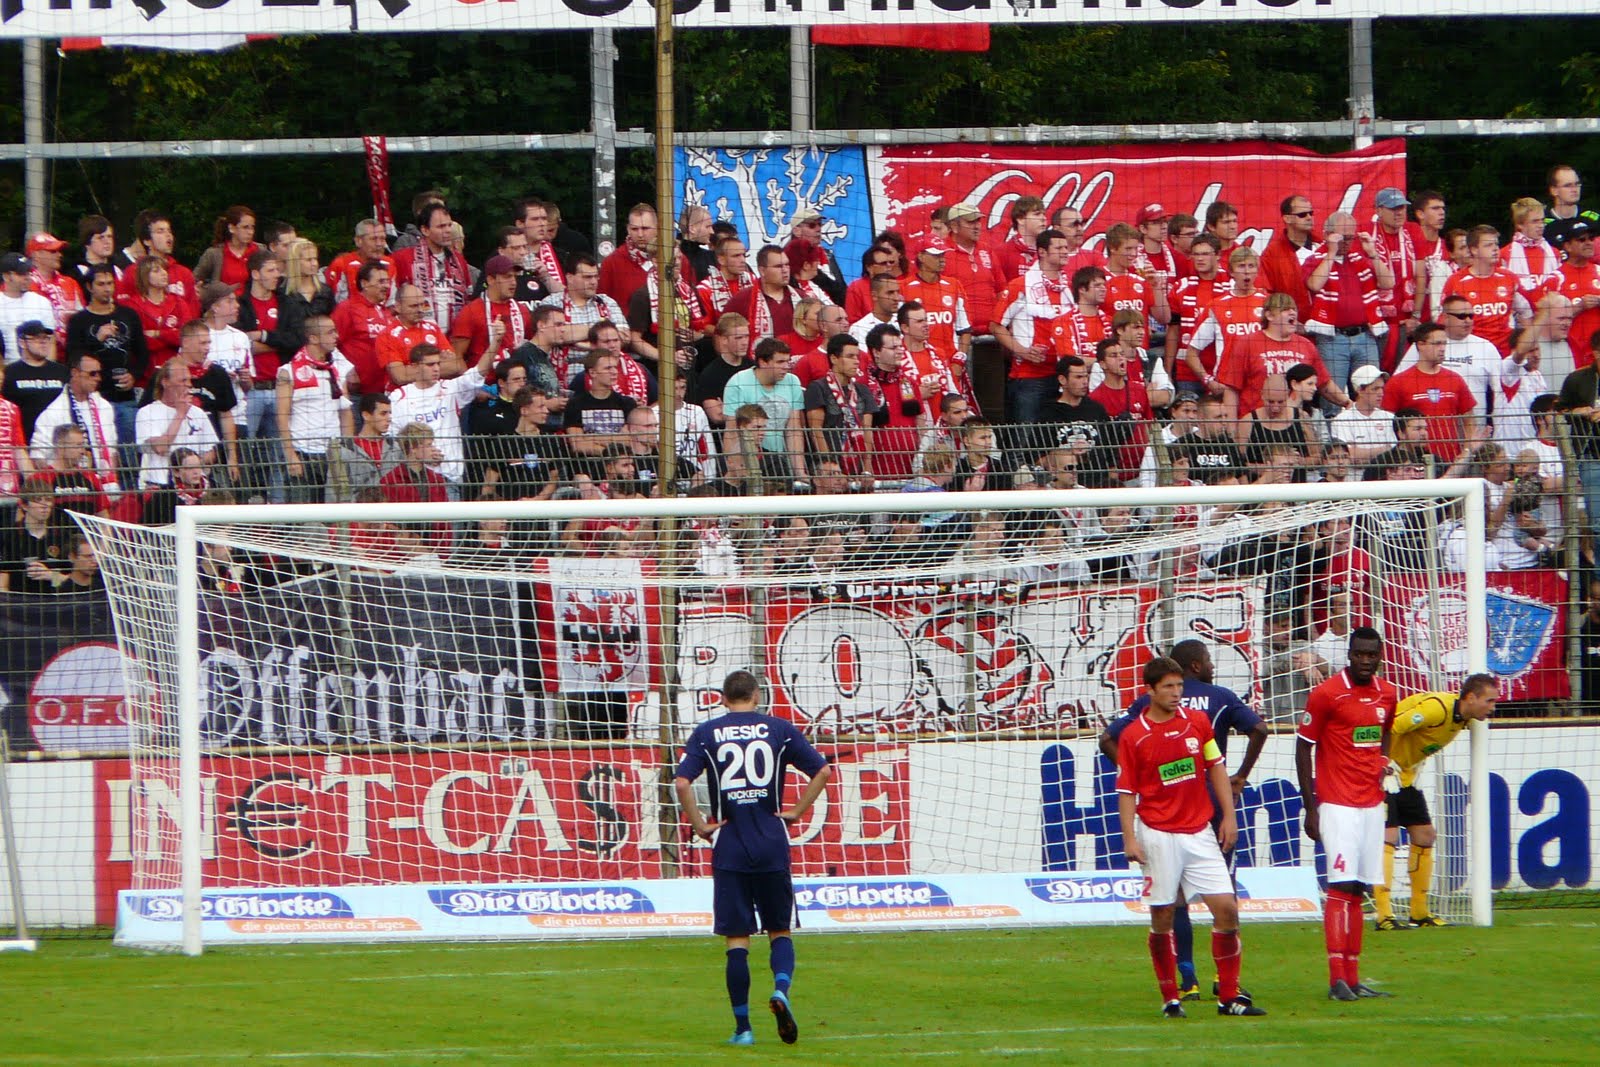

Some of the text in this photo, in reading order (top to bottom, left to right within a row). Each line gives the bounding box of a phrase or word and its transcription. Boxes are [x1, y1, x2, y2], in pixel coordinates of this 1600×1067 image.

[713, 723, 769, 743] MESIC
[717, 740, 775, 791] 20
[727, 788, 769, 800] KICKERS
[1333, 853, 1346, 873] 4
[815, 883, 933, 907] Glocke
[1046, 879, 1110, 901] Die
[147, 890, 333, 919] De Glocke
[449, 888, 634, 913] Die Glocke
[1243, 899, 1302, 912] des Tages
[543, 913, 707, 928] die guten Seiten des Tages
[843, 905, 1005, 922] die guten Seiten des Tages
[241, 918, 406, 935] die guten Seiten des Tages
